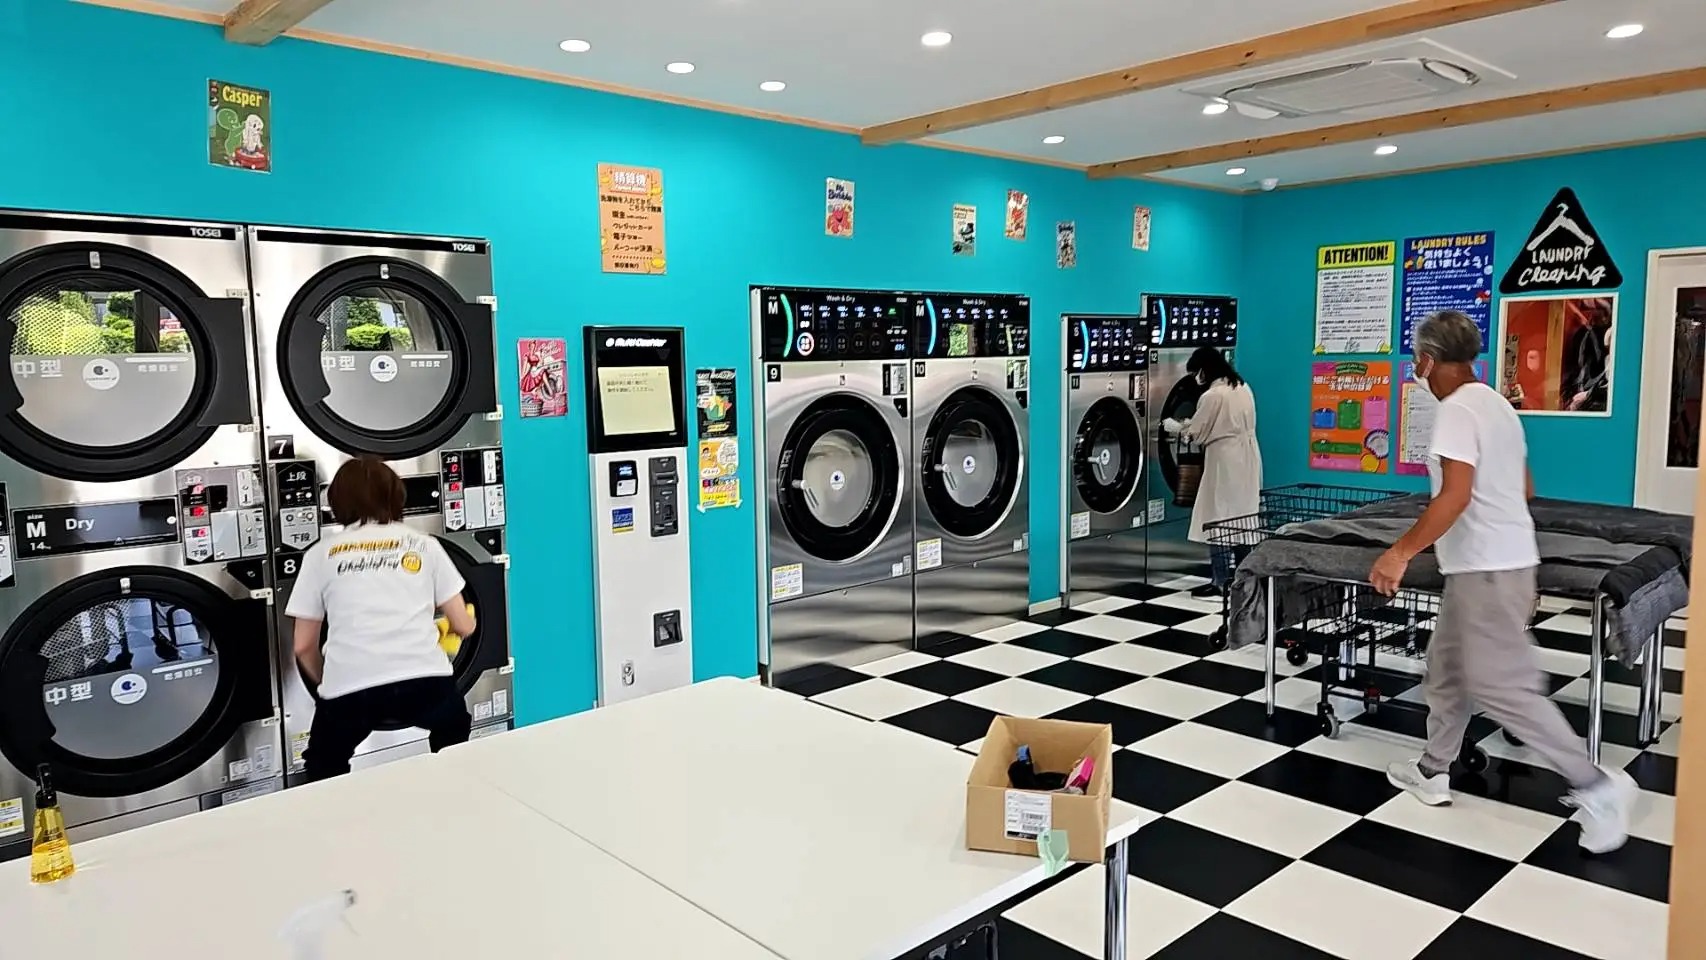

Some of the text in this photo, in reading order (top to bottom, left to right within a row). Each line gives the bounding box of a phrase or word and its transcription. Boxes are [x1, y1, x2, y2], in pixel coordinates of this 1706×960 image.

[222, 85, 263, 107] Casper
[190, 227, 221, 238] TOSEI
[452, 243, 475, 252] TOSEI
[1411, 234, 1487, 250] LAUNDRY RULES
[1323, 245, 1389, 265] ATTENTION!
[1424, 246, 1471, 259] 気持ちよく
[1531, 245, 1593, 264] LAUNDRY
[1518, 263, 1606, 287] Cleaning
[768, 301, 778, 315] M
[916, 305, 925, 317] M
[322, 355, 356, 371] 中型
[1151, 353, 1158, 362] 12
[13, 359, 63, 378] 中型
[770, 368, 778, 379] 9
[915, 364, 924, 375] 10
[1072, 377, 1079, 387] 11
[275, 439, 287, 455] 7
[286, 471, 306, 481] 上段
[26, 521, 46, 538] M
[65, 518, 95, 531] Dry
[290, 532, 312, 543] 下段
[191, 549, 208, 557] 下段
[284, 559, 296, 574] 8
[45, 681, 93, 705] 中型
